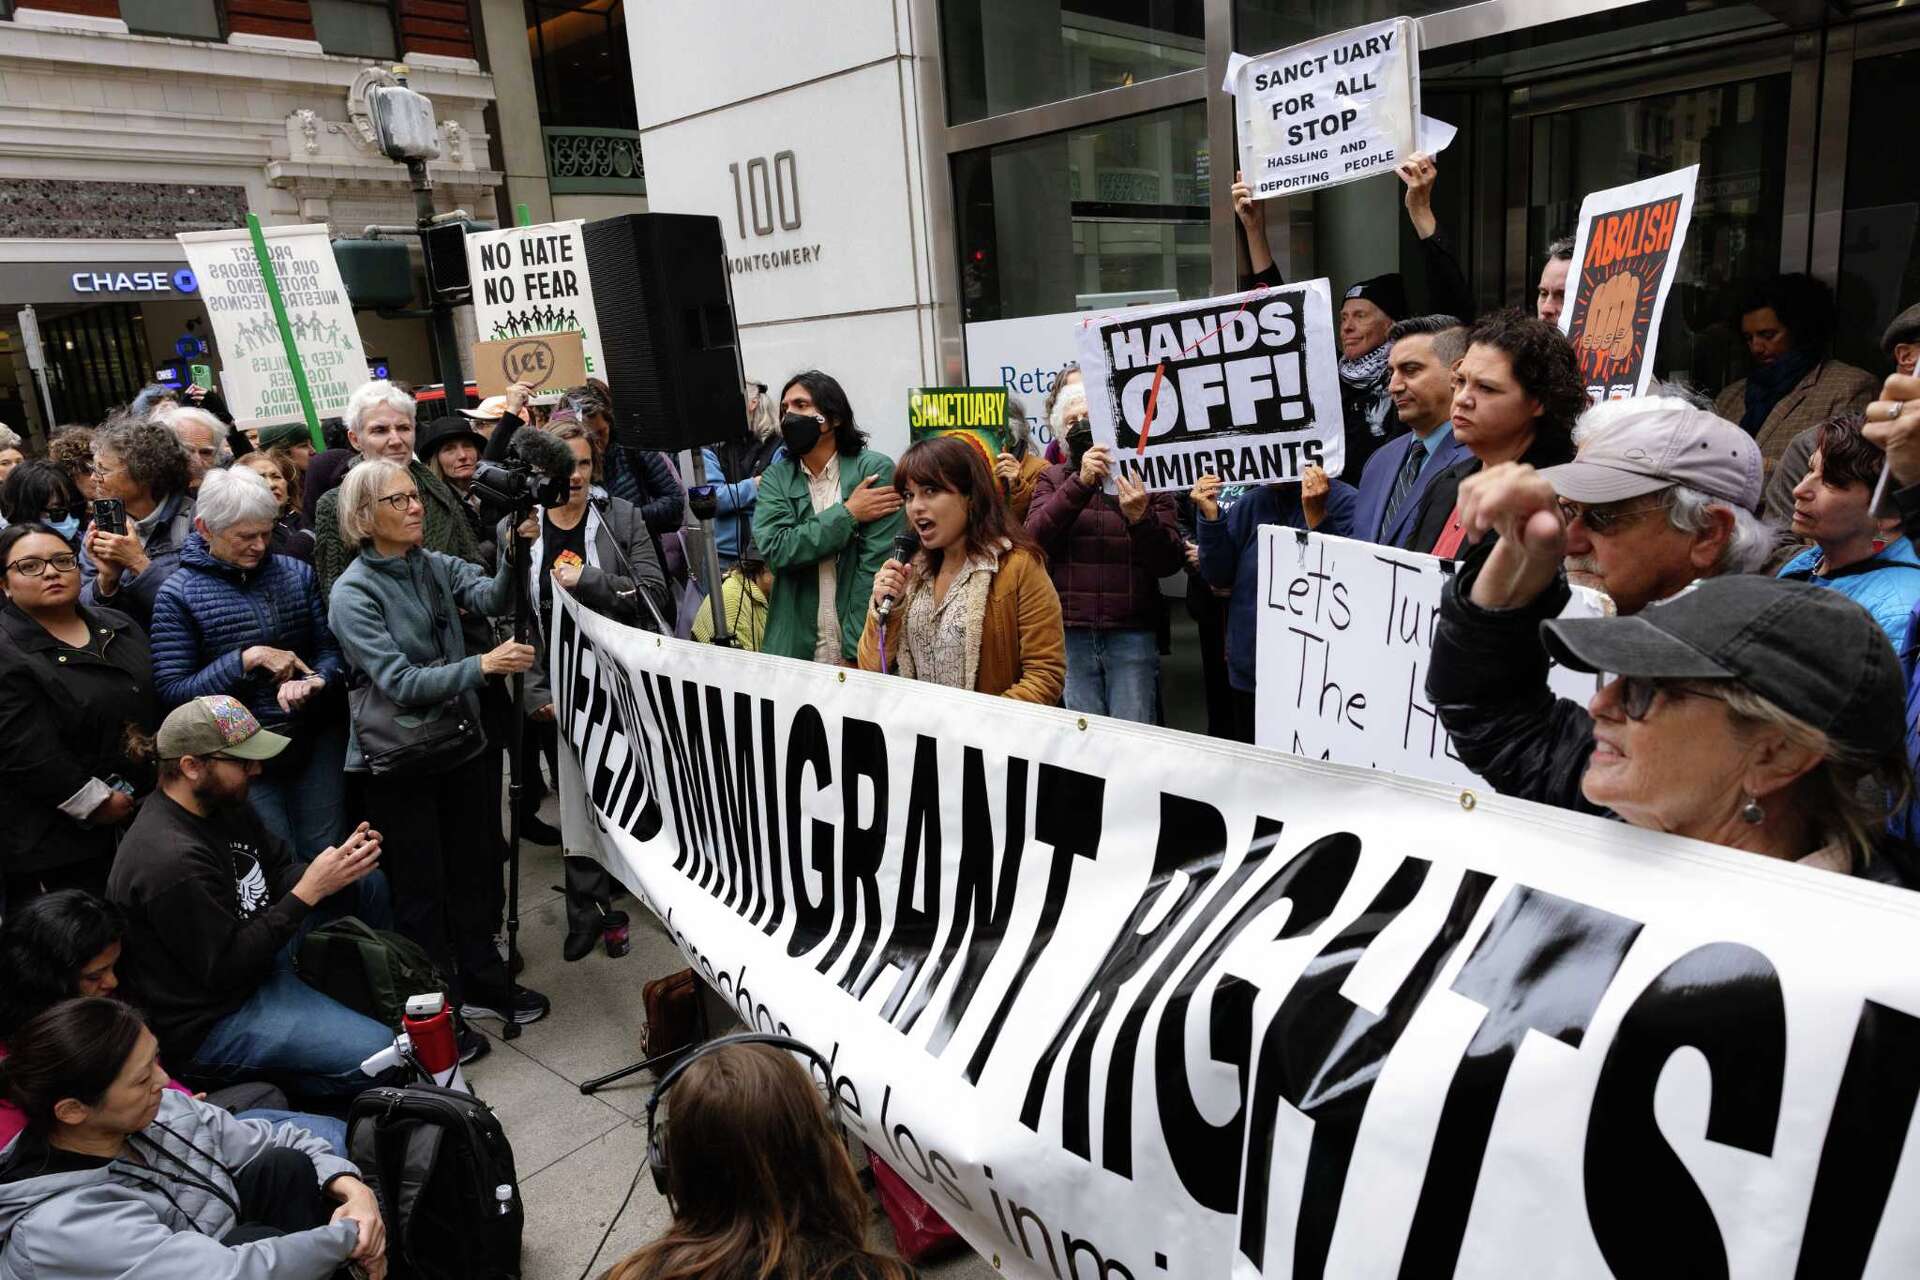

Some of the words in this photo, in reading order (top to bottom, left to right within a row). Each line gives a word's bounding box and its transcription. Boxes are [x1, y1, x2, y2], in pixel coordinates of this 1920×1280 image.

[1272, 93, 1315, 120] FOR
[1335, 73, 1376, 96] ALL
[1288, 109, 1357, 146] STOP
[1261, 171, 1329, 192] DEPORTING
[1344, 150, 1395, 172] PEOPLE
[1267, 150, 1328, 168] HASSLING
[1340, 140, 1367, 155] AND
[729, 150, 801, 240] 100
[480, 242, 511, 271] NO
[520, 235, 574, 267] HATE
[1584, 200, 1678, 268] ABOLISH
[72, 272, 171, 292] CHASE
[484, 276, 515, 305] NO
[524, 269, 579, 300] FEAR
[1110, 301, 1296, 371] HANDS
[511, 351, 547, 375] ICE
[911, 393, 1005, 427] SANCTUARY
[1121, 351, 1304, 437] OFF!
[1120, 440, 1323, 488] IMMIGRANTS
[1269, 534, 1351, 631] Let's
[1289, 627, 1366, 731] The
[558, 602, 663, 842] DEFEND
[640, 670, 1106, 1088] IMMIGRANT
[881, 1085, 973, 1211] los
